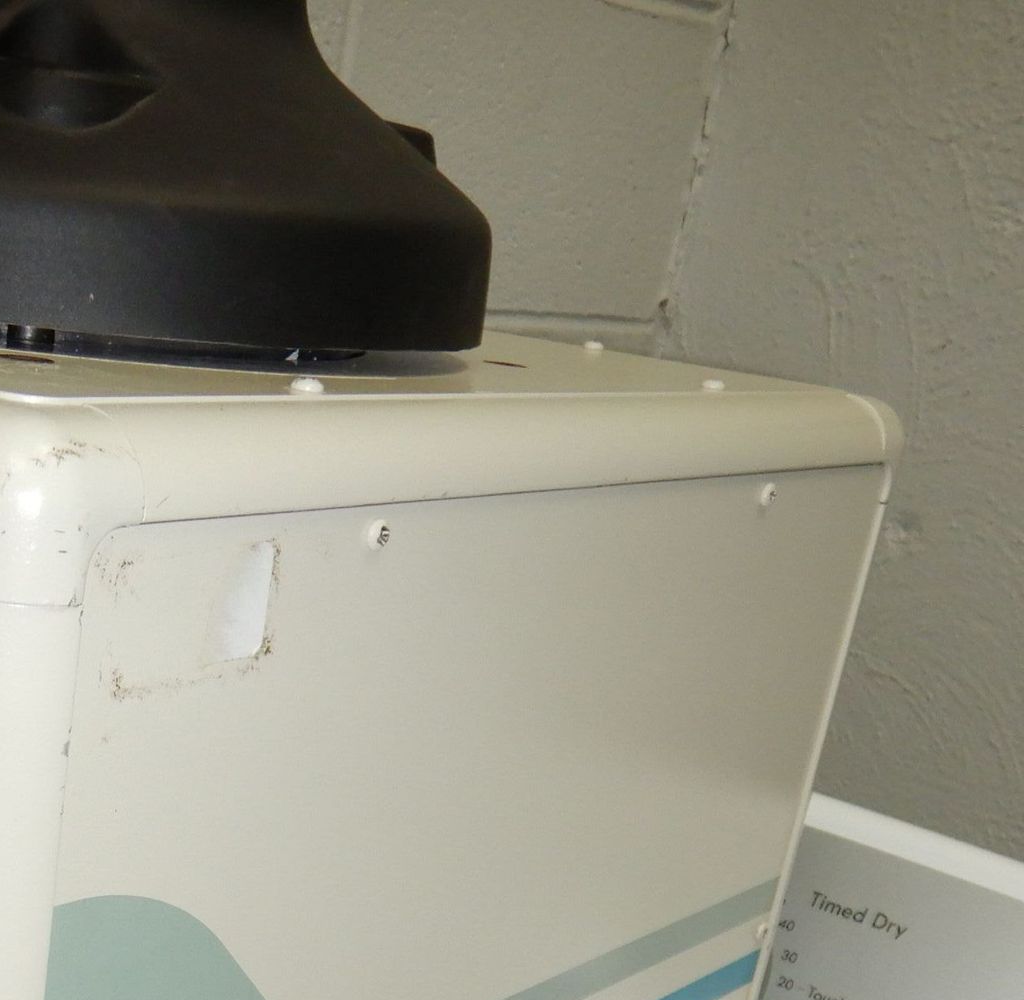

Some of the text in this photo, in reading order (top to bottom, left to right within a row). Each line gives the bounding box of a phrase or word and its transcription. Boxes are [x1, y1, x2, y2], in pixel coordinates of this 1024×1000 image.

[810, 891, 908, 940] Timed Dry
[778, 919, 795, 932] 40
[781, 949, 798, 964] 30
[777, 976, 794, 991] 20
